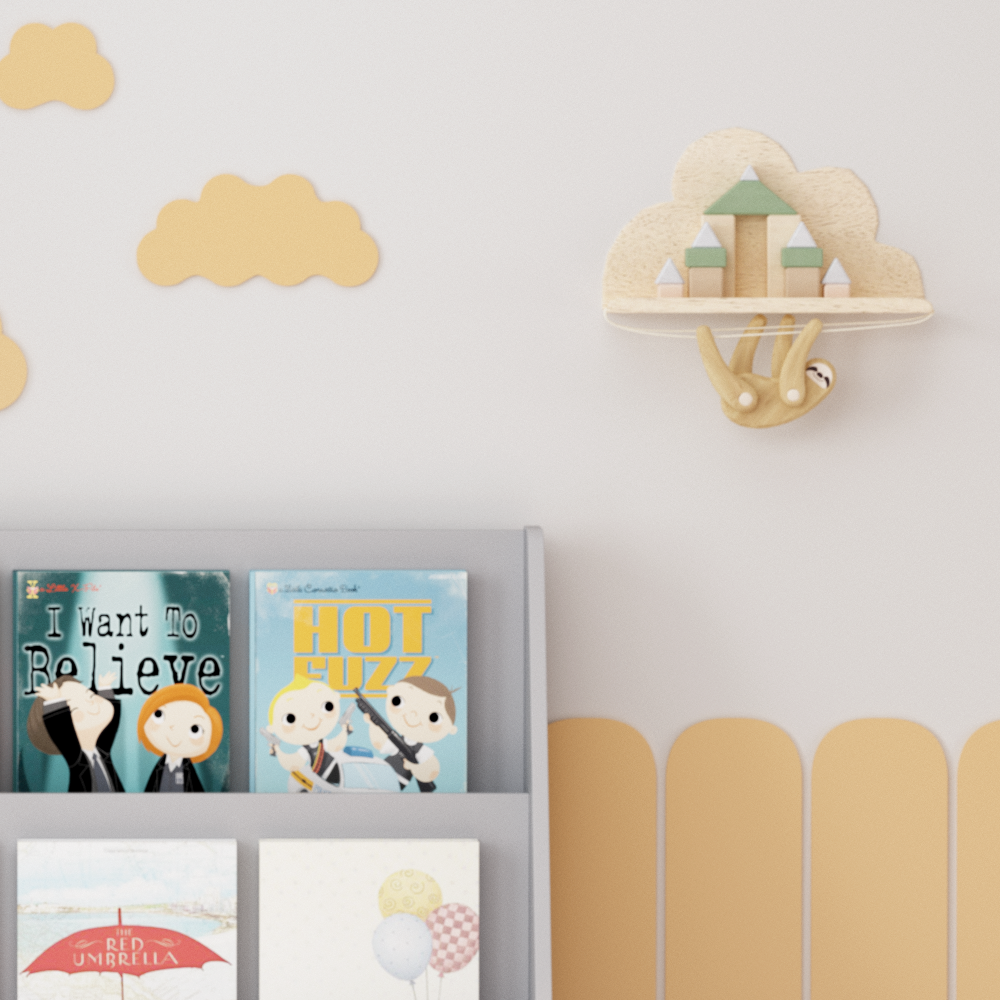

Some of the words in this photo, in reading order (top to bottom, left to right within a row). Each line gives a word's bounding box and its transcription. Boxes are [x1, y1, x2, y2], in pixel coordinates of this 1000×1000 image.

[47, 606, 62, 638] I
[78, 605, 149, 638] Want
[165, 606, 198, 639] To
[293, 605, 433, 654] HOT
[24, 641, 221, 696] Believe
[293, 655, 432, 692] FUZZ
[105, 937, 145, 952] RED
[116, 927, 134, 937] THE
[72, 951, 179, 969] UMBRELLA
